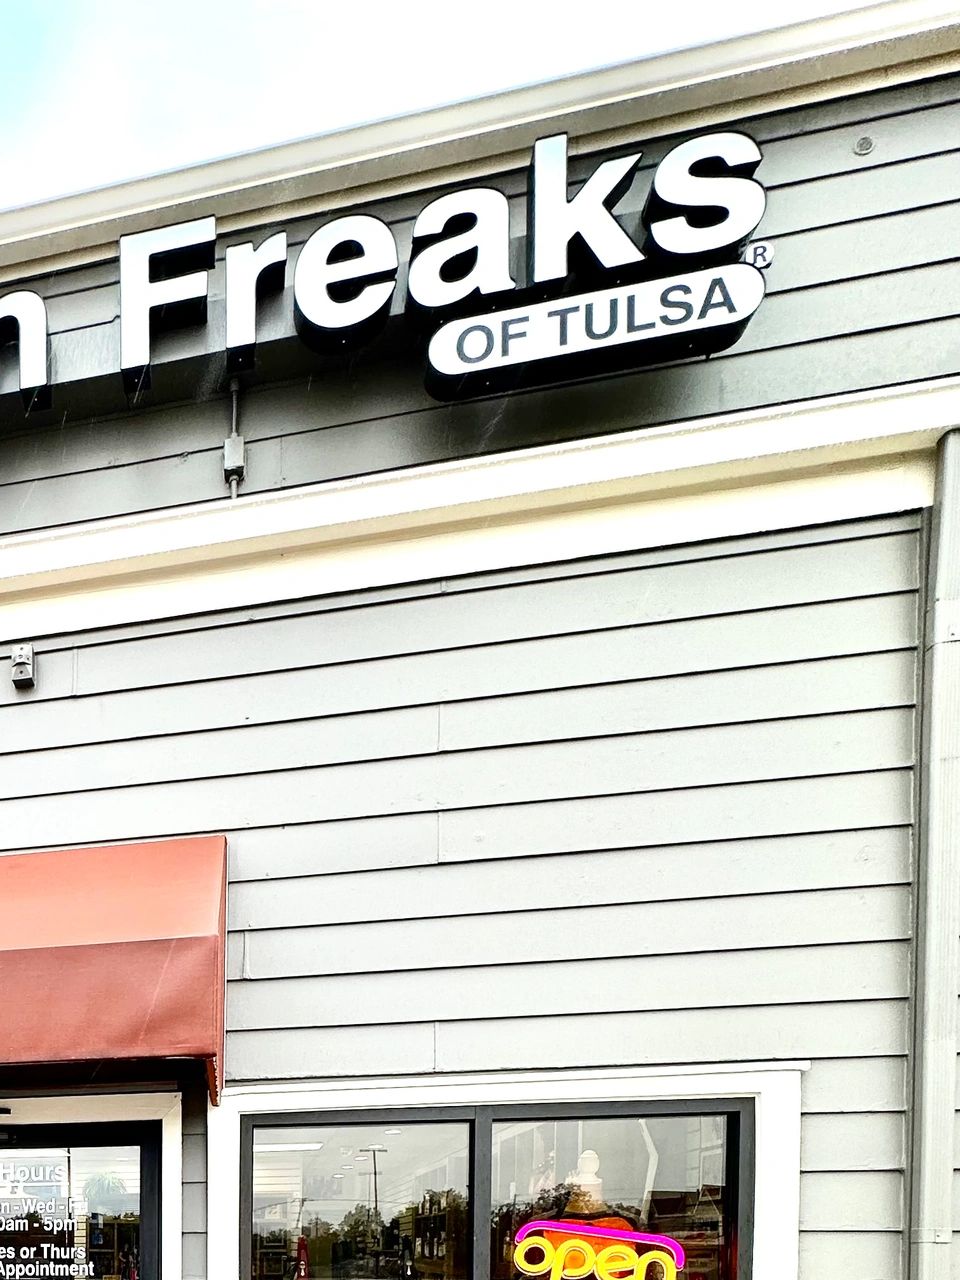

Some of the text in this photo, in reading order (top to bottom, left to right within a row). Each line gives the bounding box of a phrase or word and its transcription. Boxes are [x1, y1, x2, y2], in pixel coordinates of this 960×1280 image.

[119, 131, 767, 370] Freaks
[456, 277, 737, 364] OF TULSA
[22, 1198, 56, 1214] Wed
[43, 1217, 77, 1235] 5pm
[20, 1246, 37, 1259] or
[41, 1243, 87, 1259] Thurs
